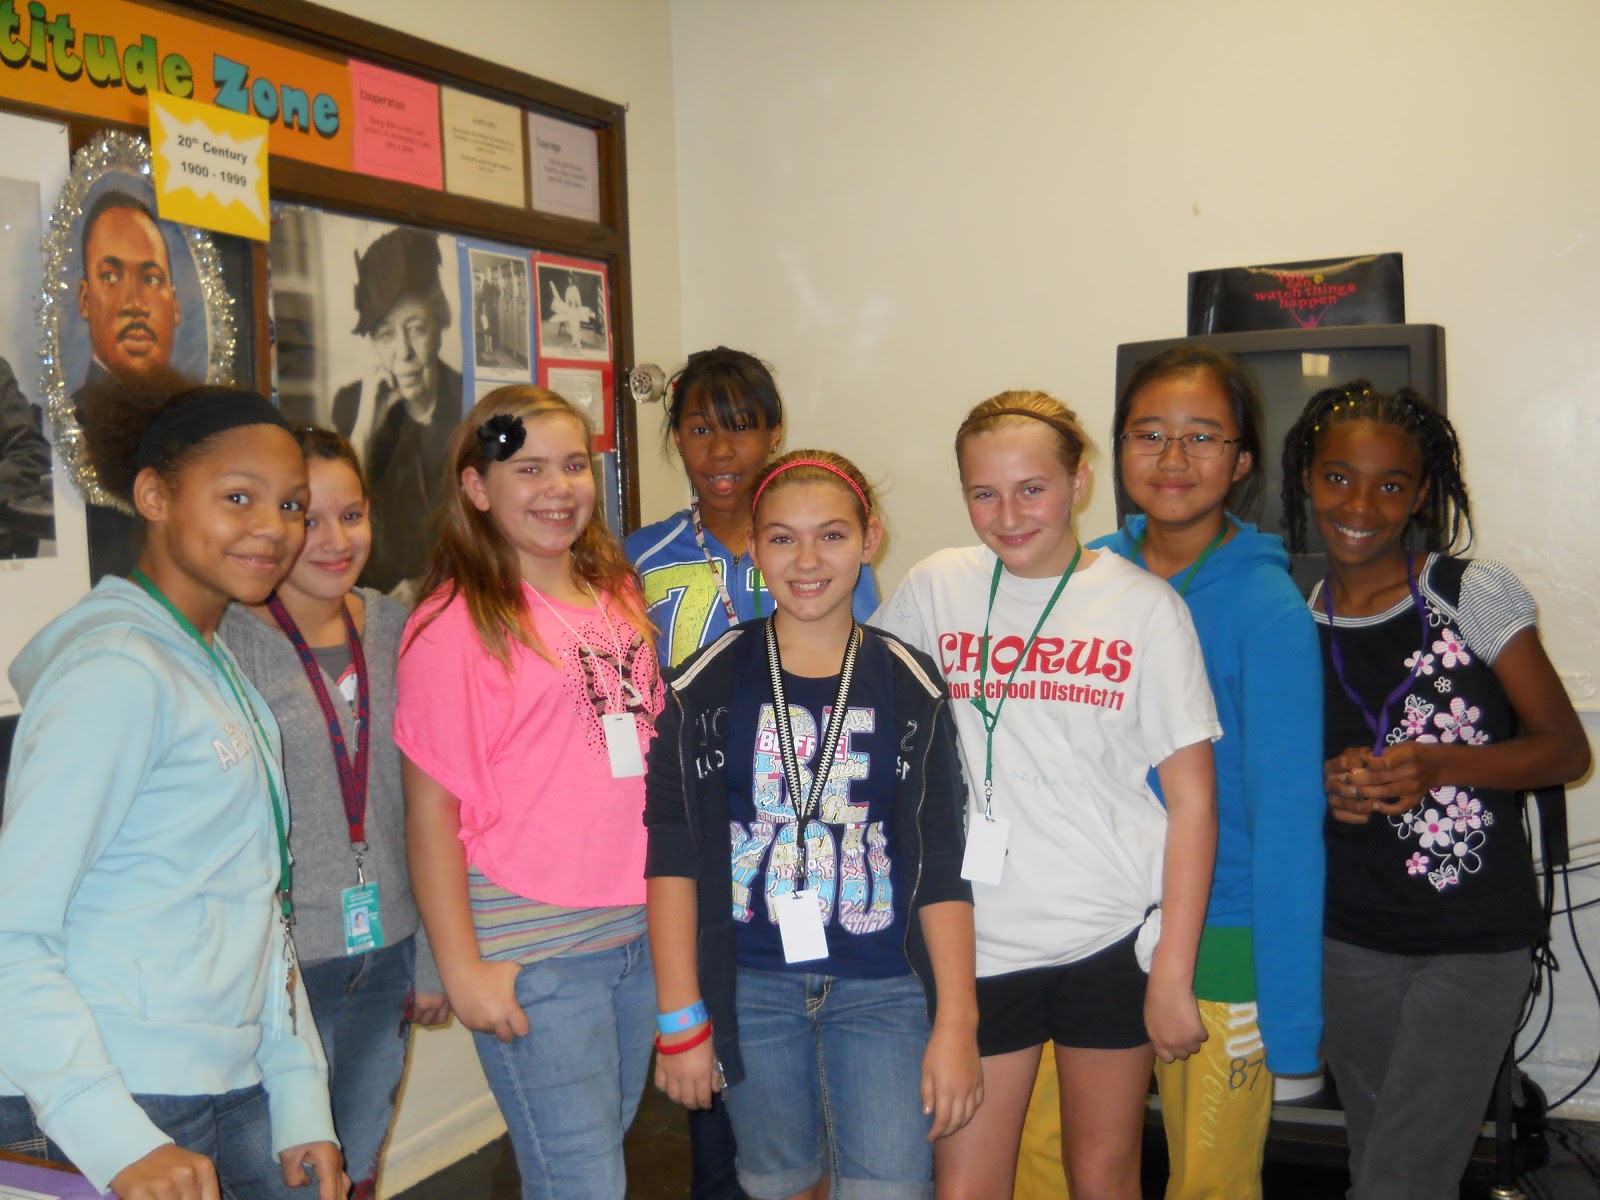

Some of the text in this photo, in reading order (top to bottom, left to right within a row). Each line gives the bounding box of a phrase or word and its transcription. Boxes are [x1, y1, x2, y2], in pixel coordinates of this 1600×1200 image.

[213, 53, 340, 139] Zone
[359, 89, 405, 111] Cooperation
[203, 141, 247, 166] Century
[181, 161, 209, 178] 1900
[220, 170, 247, 187] 1999
[1254, 283, 1357, 302] watch things
[1279, 295, 1338, 312] happen
[938, 631, 1134, 684] CHORUS
[973, 678, 1036, 700] School
[1040, 680, 1109, 708] District
